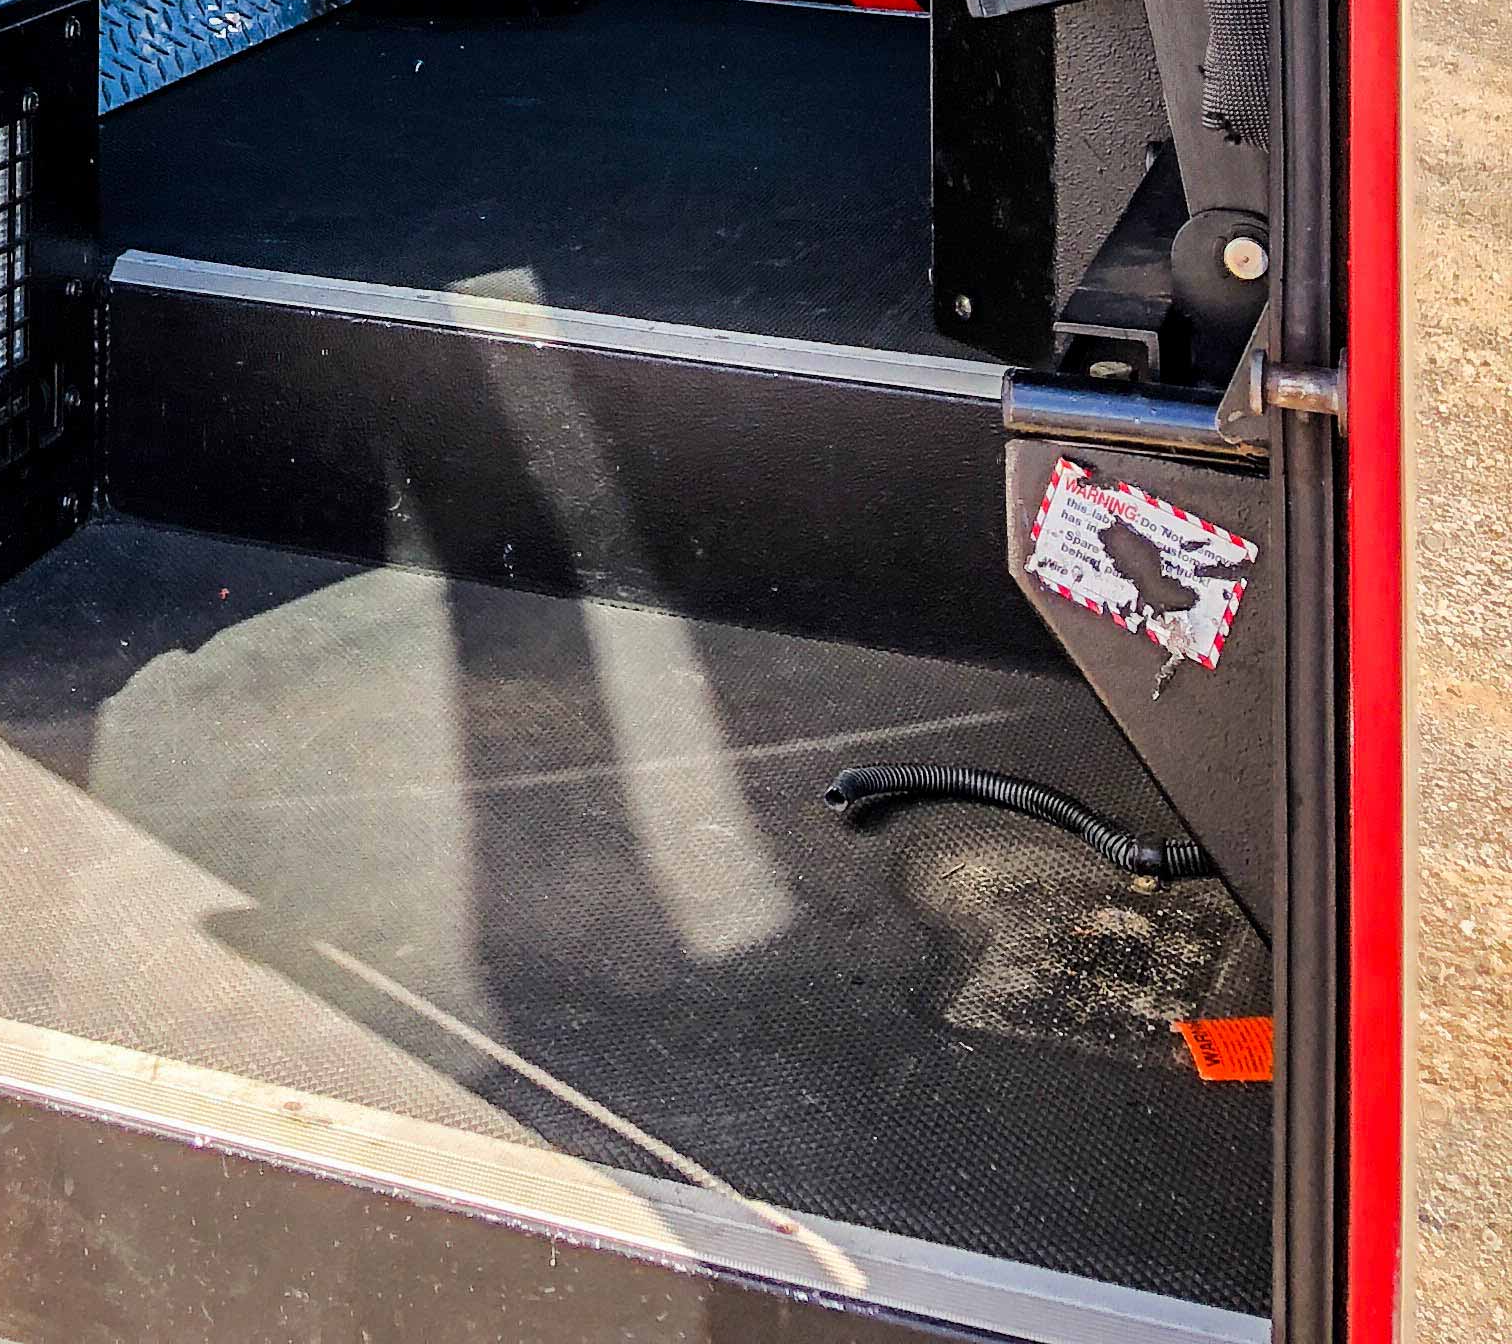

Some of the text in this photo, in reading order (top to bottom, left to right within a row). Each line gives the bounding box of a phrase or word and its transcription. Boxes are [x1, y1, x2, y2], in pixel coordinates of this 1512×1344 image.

[1060, 508, 1082, 527] has
[1066, 496, 1088, 515] this
[1091, 508, 1114, 525] lab
[1064, 529, 1100, 554] Spare
[1139, 516, 1158, 533] Do
[1161, 524, 1185, 550] Not
